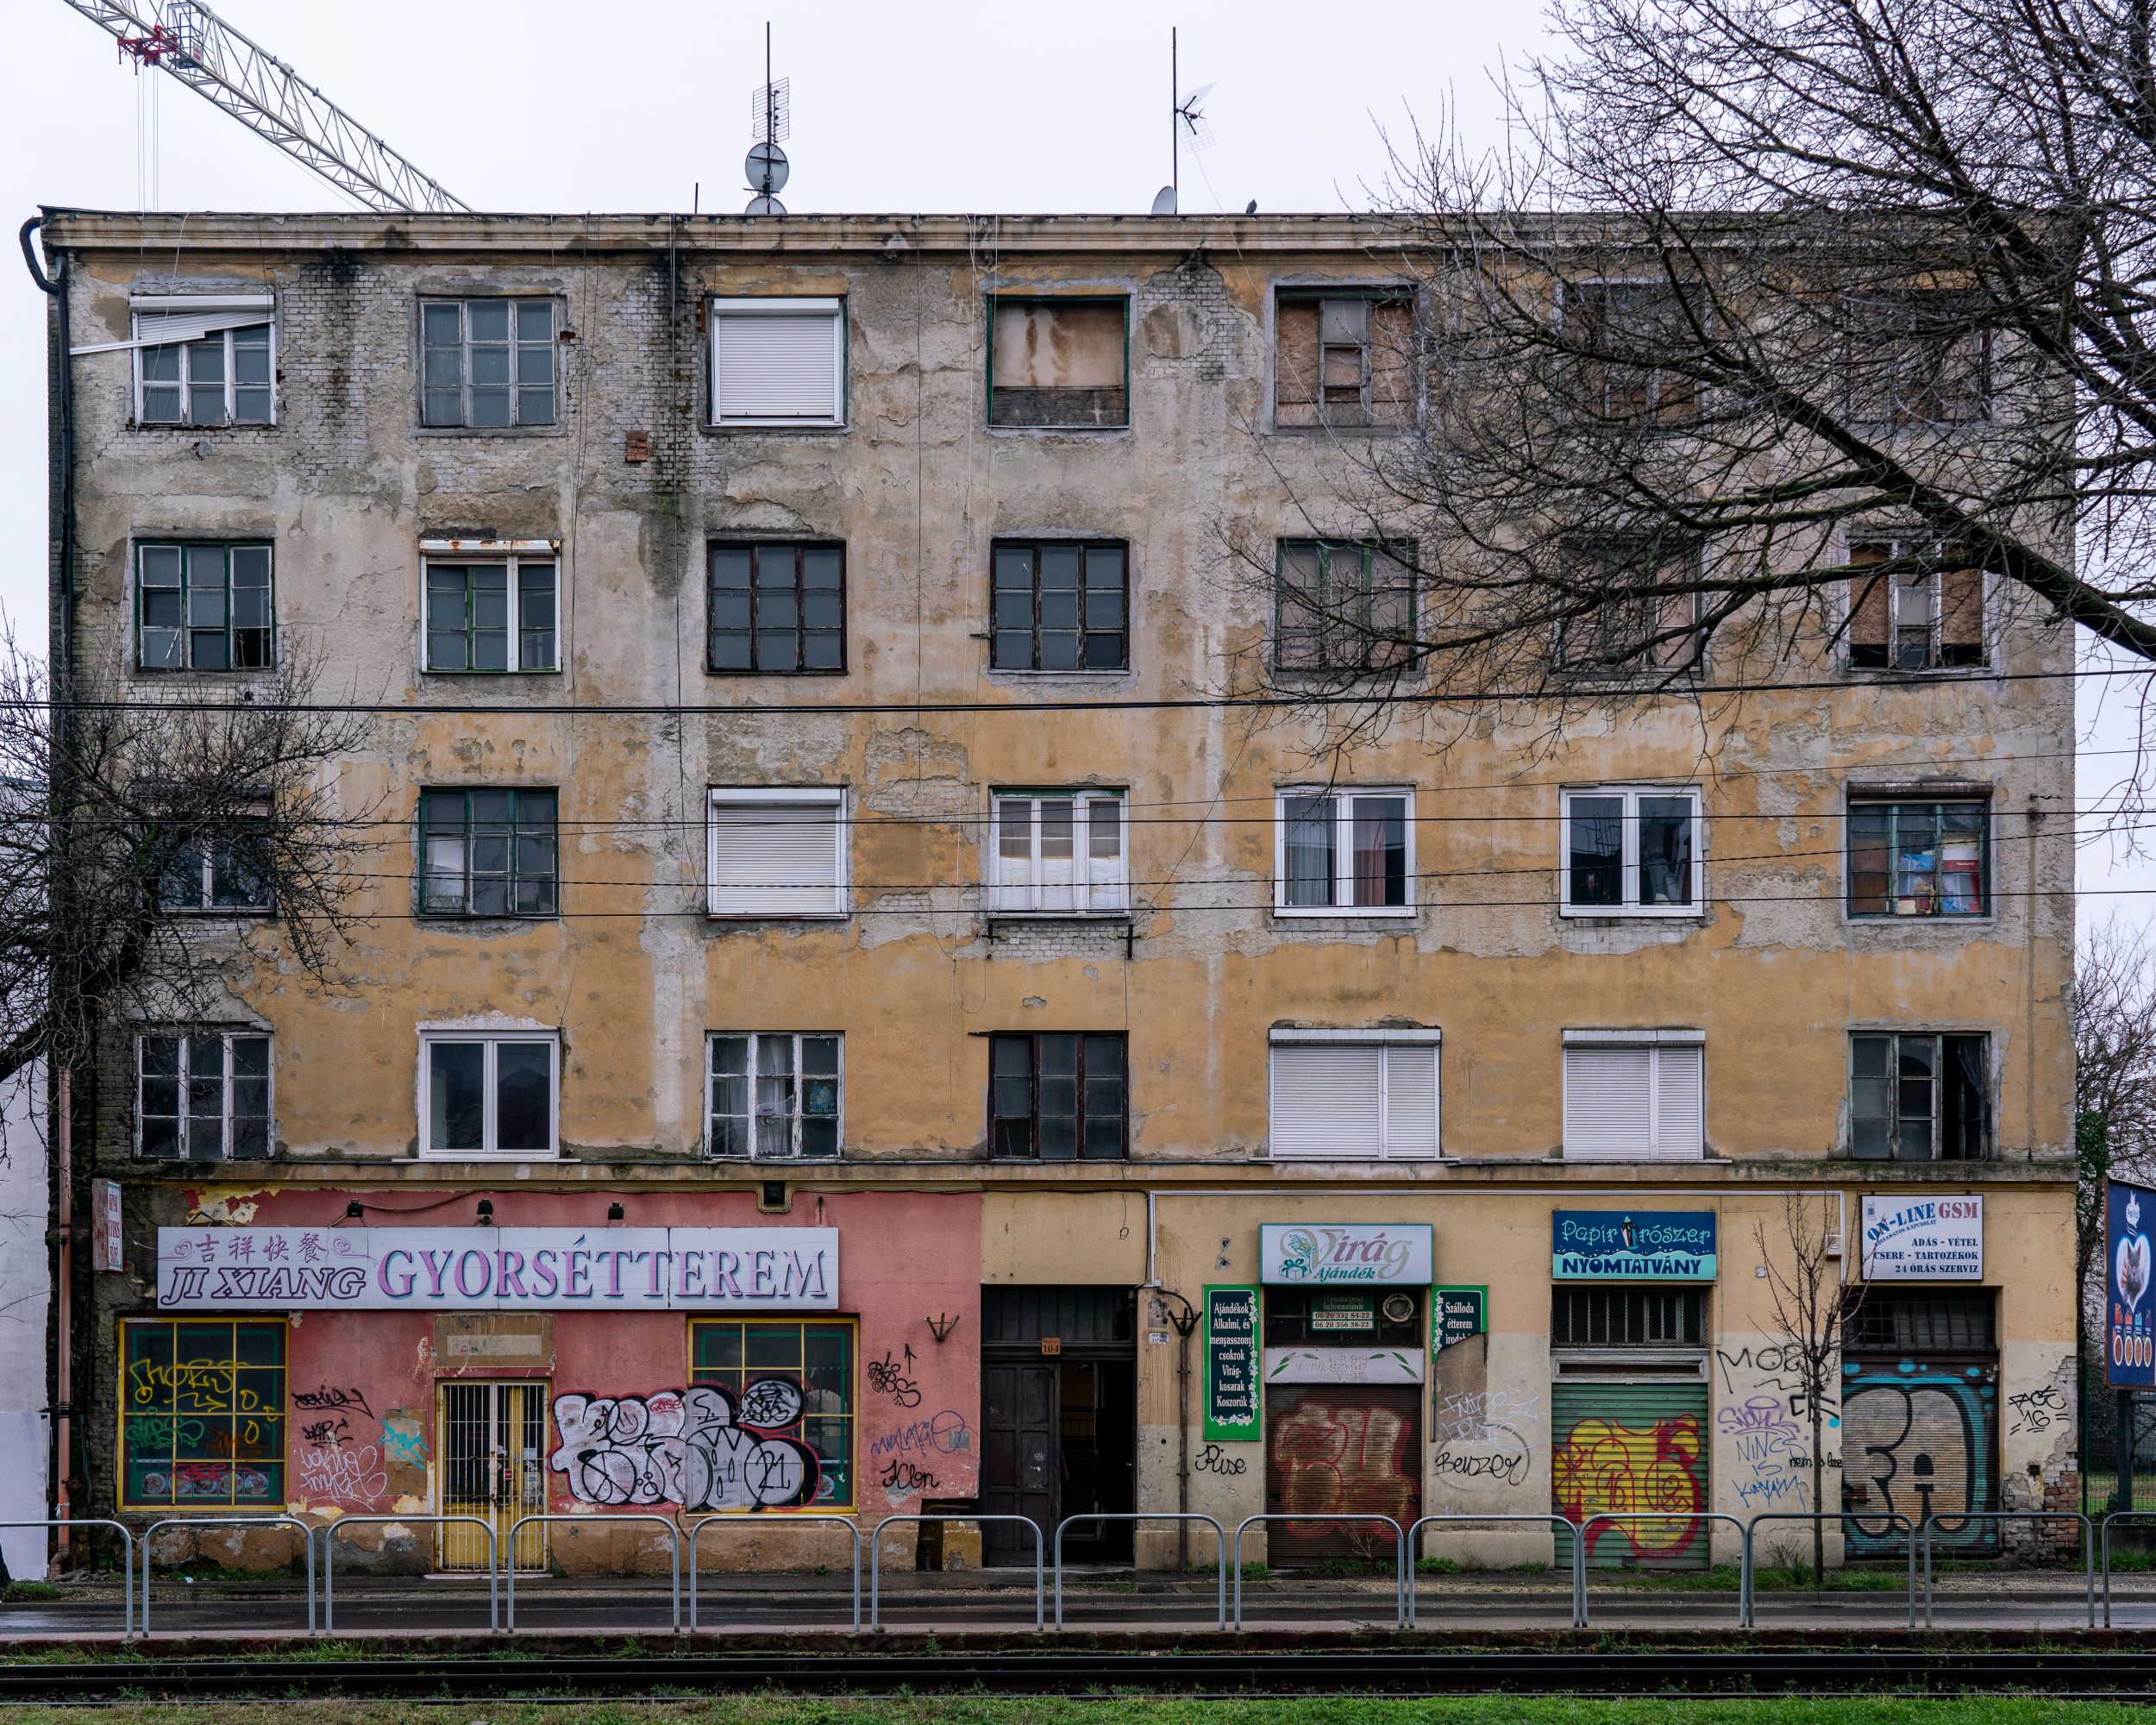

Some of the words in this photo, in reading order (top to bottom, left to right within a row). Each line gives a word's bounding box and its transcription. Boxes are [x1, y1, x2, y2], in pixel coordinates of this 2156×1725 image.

[1867, 1202, 1936, 1240] ON-LINE
[1938, 1201, 1978, 1220] GSM
[1562, 1220, 1618, 1246] Papír
[1639, 1224, 1711, 1245] rószer
[195, 1232, 327, 1264] 吉祥快餐
[1911, 1237, 1938, 1247] ADÁS
[1947, 1237, 1978, 1247] VÉTEL
[1280, 1228, 1413, 1280] Virág
[1874, 1251, 1905, 1260] CSERE
[1915, 1250, 1978, 1260] TARTOZÉKOK
[377, 1233, 828, 1298] GYORSÉTTEREM
[1562, 1256, 1702, 1274] NYOMTATVÁNY
[1896, 1264, 1907, 1273] 24
[1910, 1264, 1936, 1273] ÓRÁS
[1313, 1267, 1376, 1283] Ajándék
[160, 1267, 210, 1306] JI
[211, 1267, 366, 1300] XIANG
[1214, 1302, 1250, 1316] Ajándékok
[1445, 1302, 1475, 1314] Szálloda
[1213, 1318, 1241, 1331] Alkalmi,
[1243, 1319, 1250, 1329] és
[1446, 1318, 1473, 1329] étterem
[1044, 1345, 1059, 1353] 104
[1219, 1348, 1245, 1360] csokrok
[1222, 1363, 1242, 1378] Virág-
[1219, 1380, 1244, 1391] kosarak
[1217, 1395, 1248, 1407] Koszorúk
